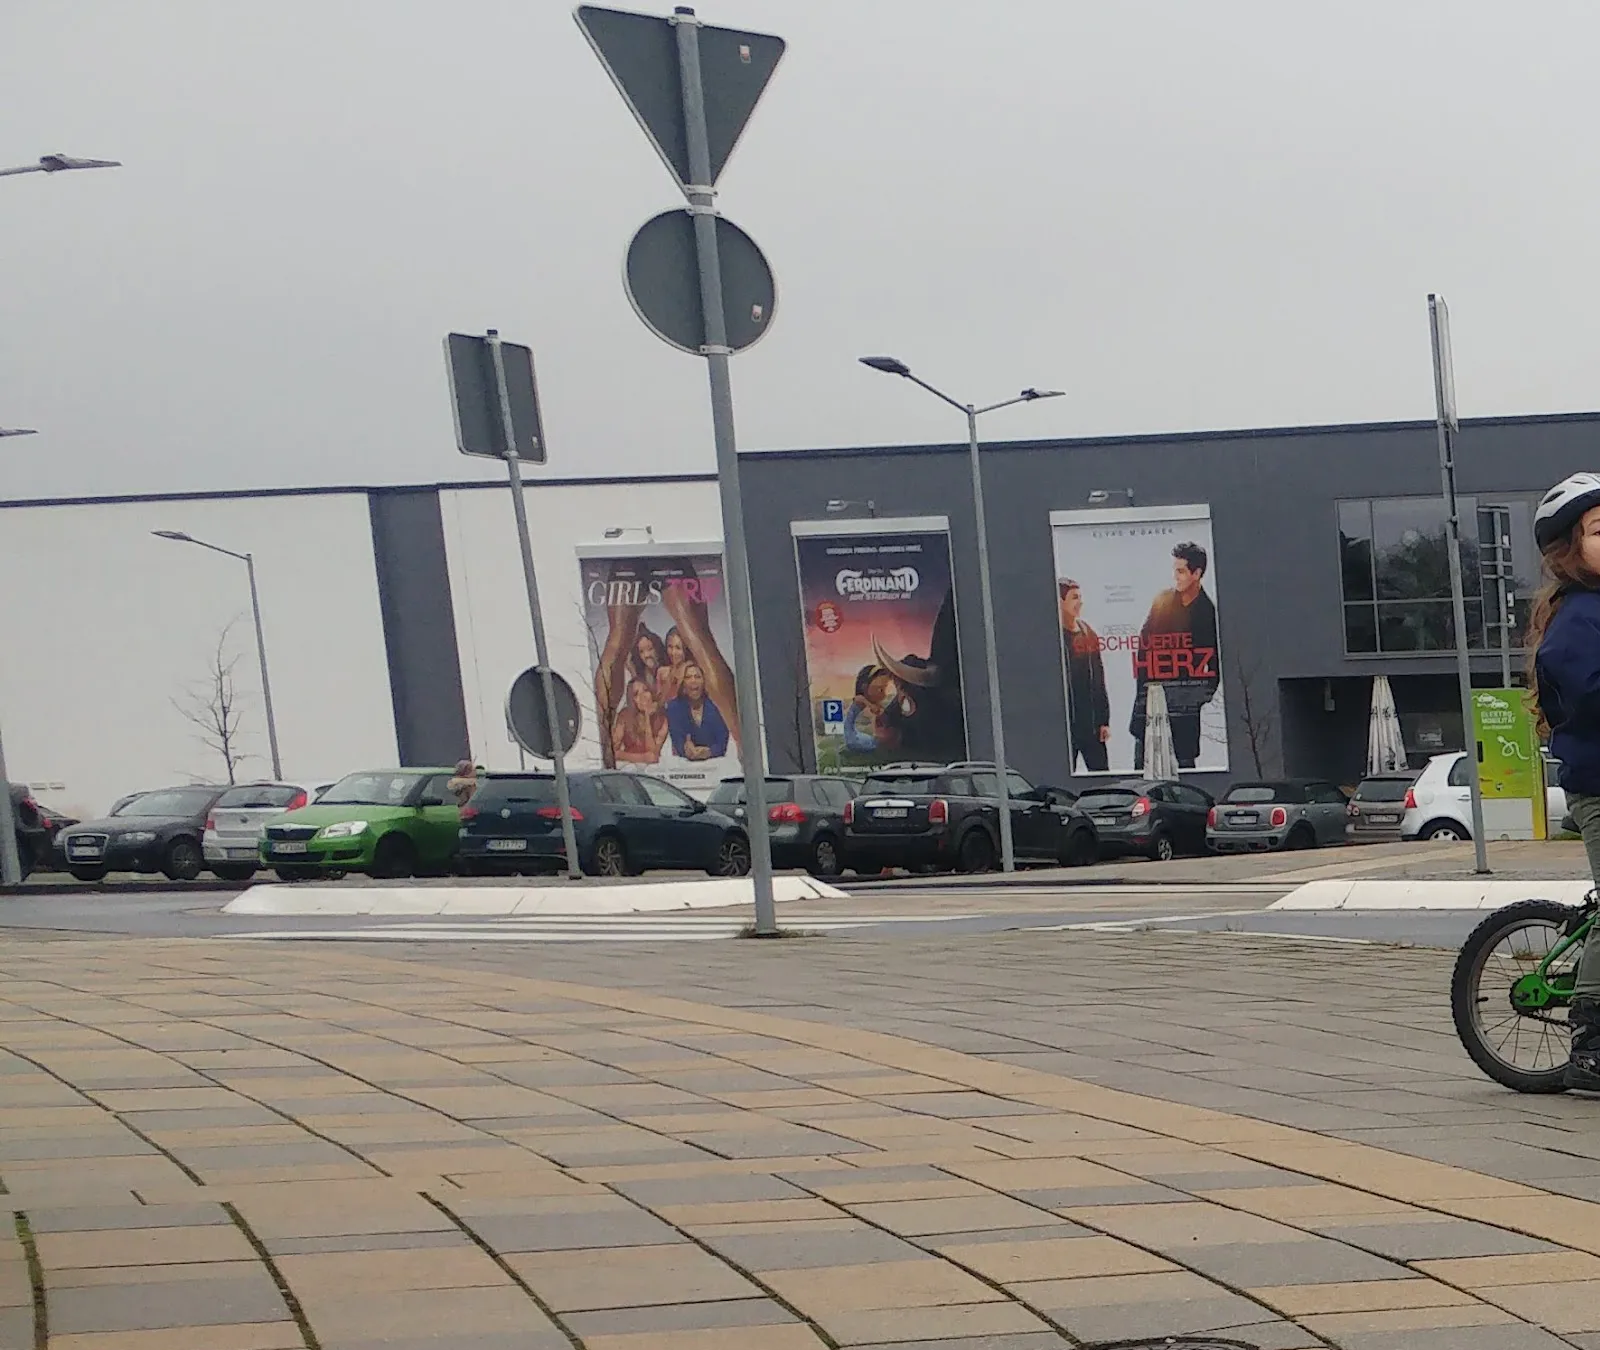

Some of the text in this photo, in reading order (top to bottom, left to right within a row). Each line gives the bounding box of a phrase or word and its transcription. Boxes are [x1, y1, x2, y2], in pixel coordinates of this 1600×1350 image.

[588, 580, 662, 606] GIRLS
[835, 566, 920, 597] FERDINAND
[1131, 647, 1217, 680] HERZ
[826, 701, 840, 720] P
